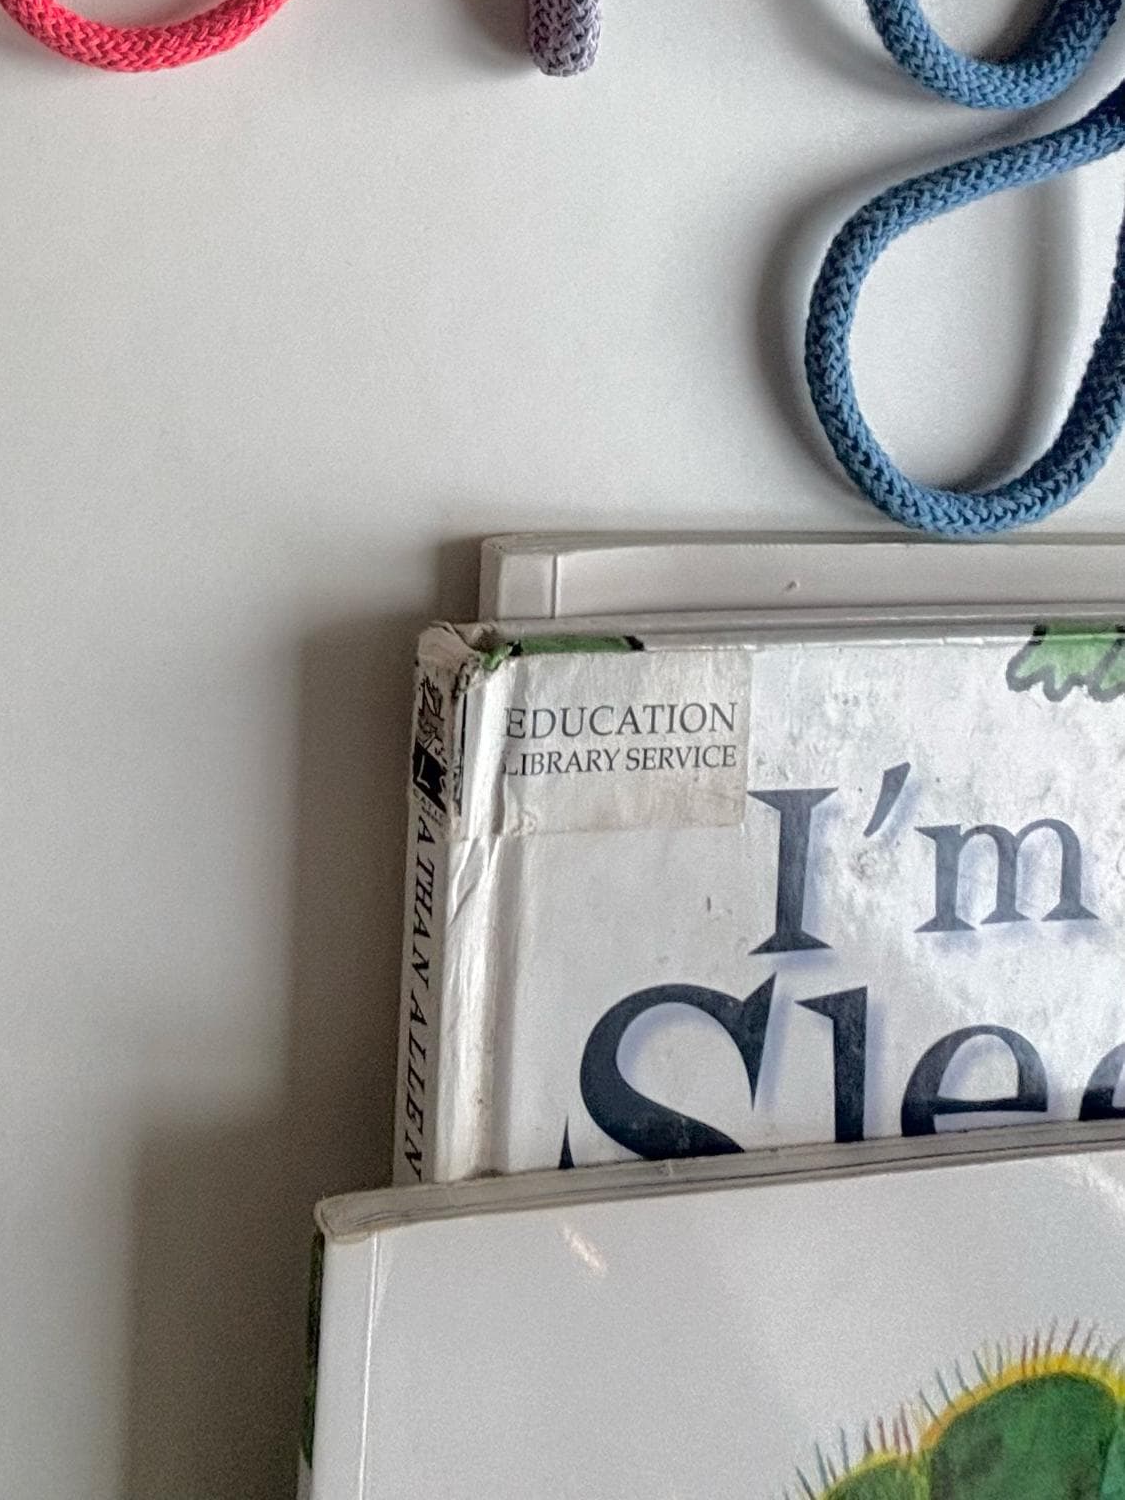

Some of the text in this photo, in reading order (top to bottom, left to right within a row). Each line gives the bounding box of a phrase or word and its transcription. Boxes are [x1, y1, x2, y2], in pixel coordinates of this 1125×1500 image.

[505, 701, 738, 740] EDUCATION
[624, 743, 738, 773] SERVICE
[746, 760, 1100, 956] I'm
[404, 987, 428, 1183] ALLEN
